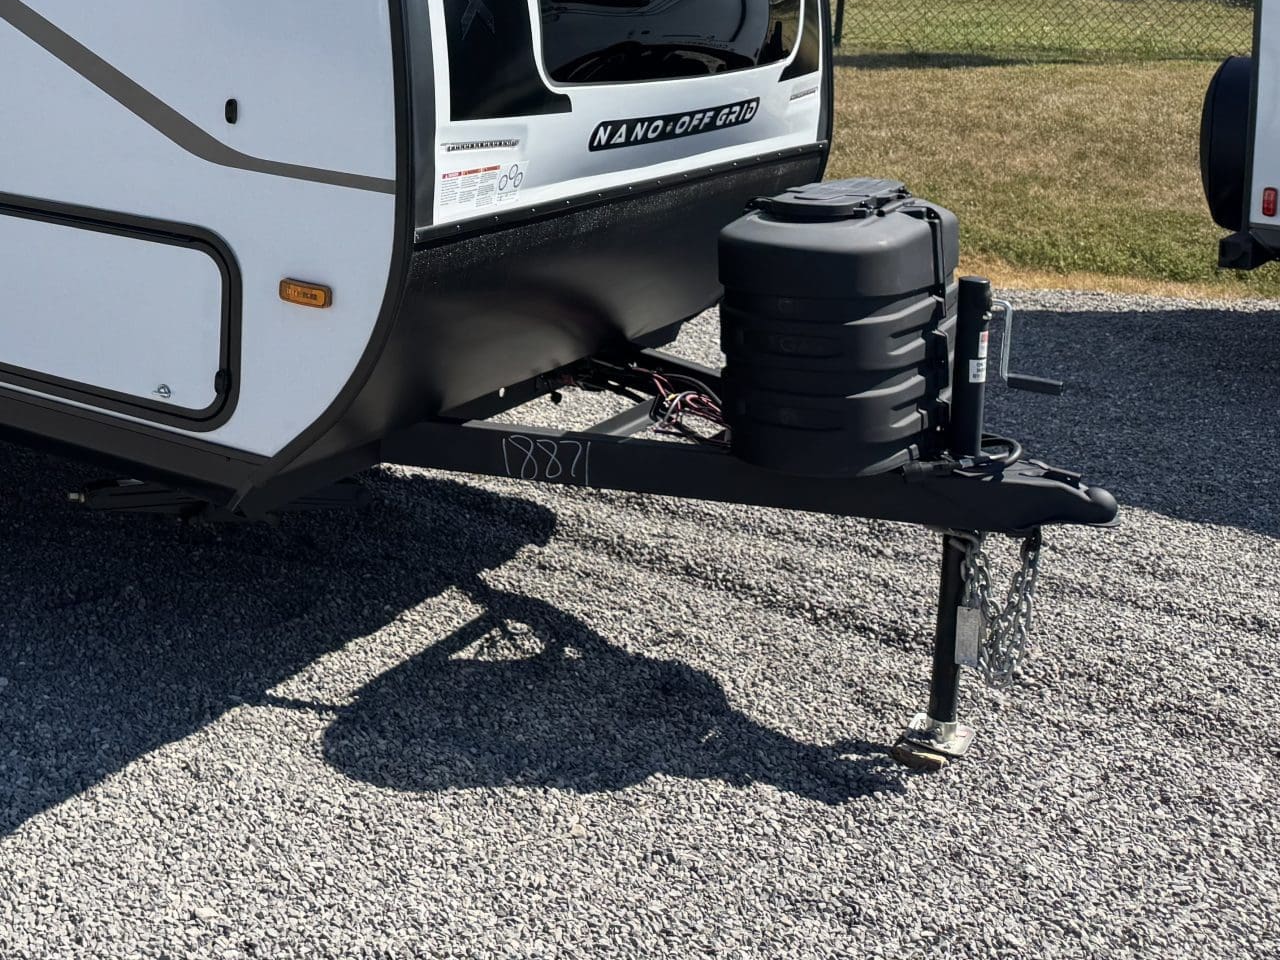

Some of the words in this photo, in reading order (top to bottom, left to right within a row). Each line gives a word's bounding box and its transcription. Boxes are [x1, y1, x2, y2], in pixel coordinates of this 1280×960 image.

[593, 119, 664, 147] NANO
[674, 109, 715, 134] OFF
[715, 101, 757, 127] GRID
[502, 434, 591, 487] 18871
